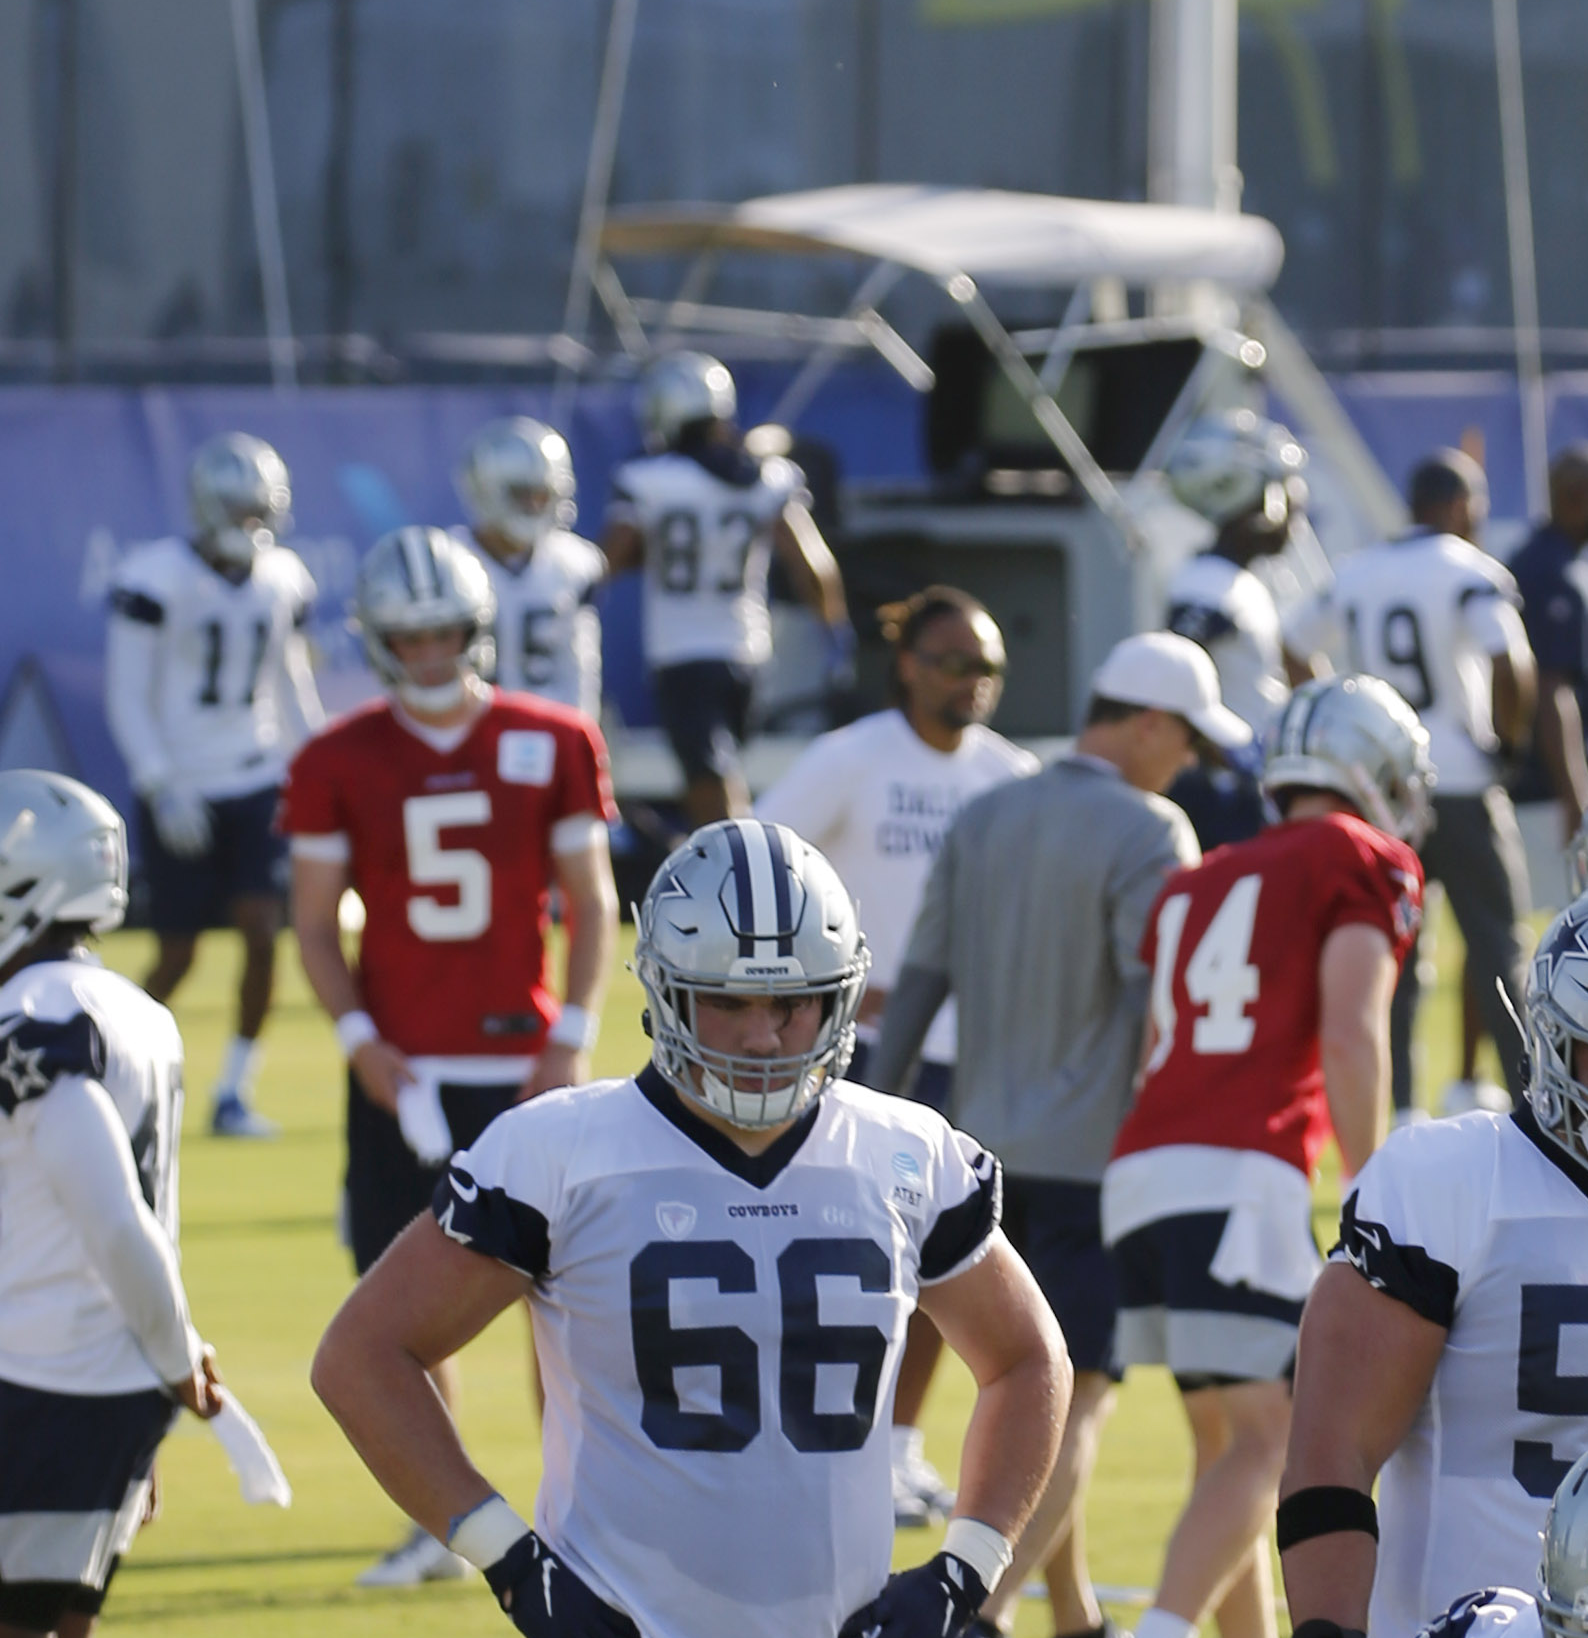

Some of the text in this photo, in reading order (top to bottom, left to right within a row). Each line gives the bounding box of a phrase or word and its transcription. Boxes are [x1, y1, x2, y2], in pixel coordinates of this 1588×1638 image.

[404, 791, 491, 941] 5
[1146, 872, 1263, 1074] 14
[727, 1203, 800, 1220] COWBOYS
[629, 1237, 893, 1454] 66
